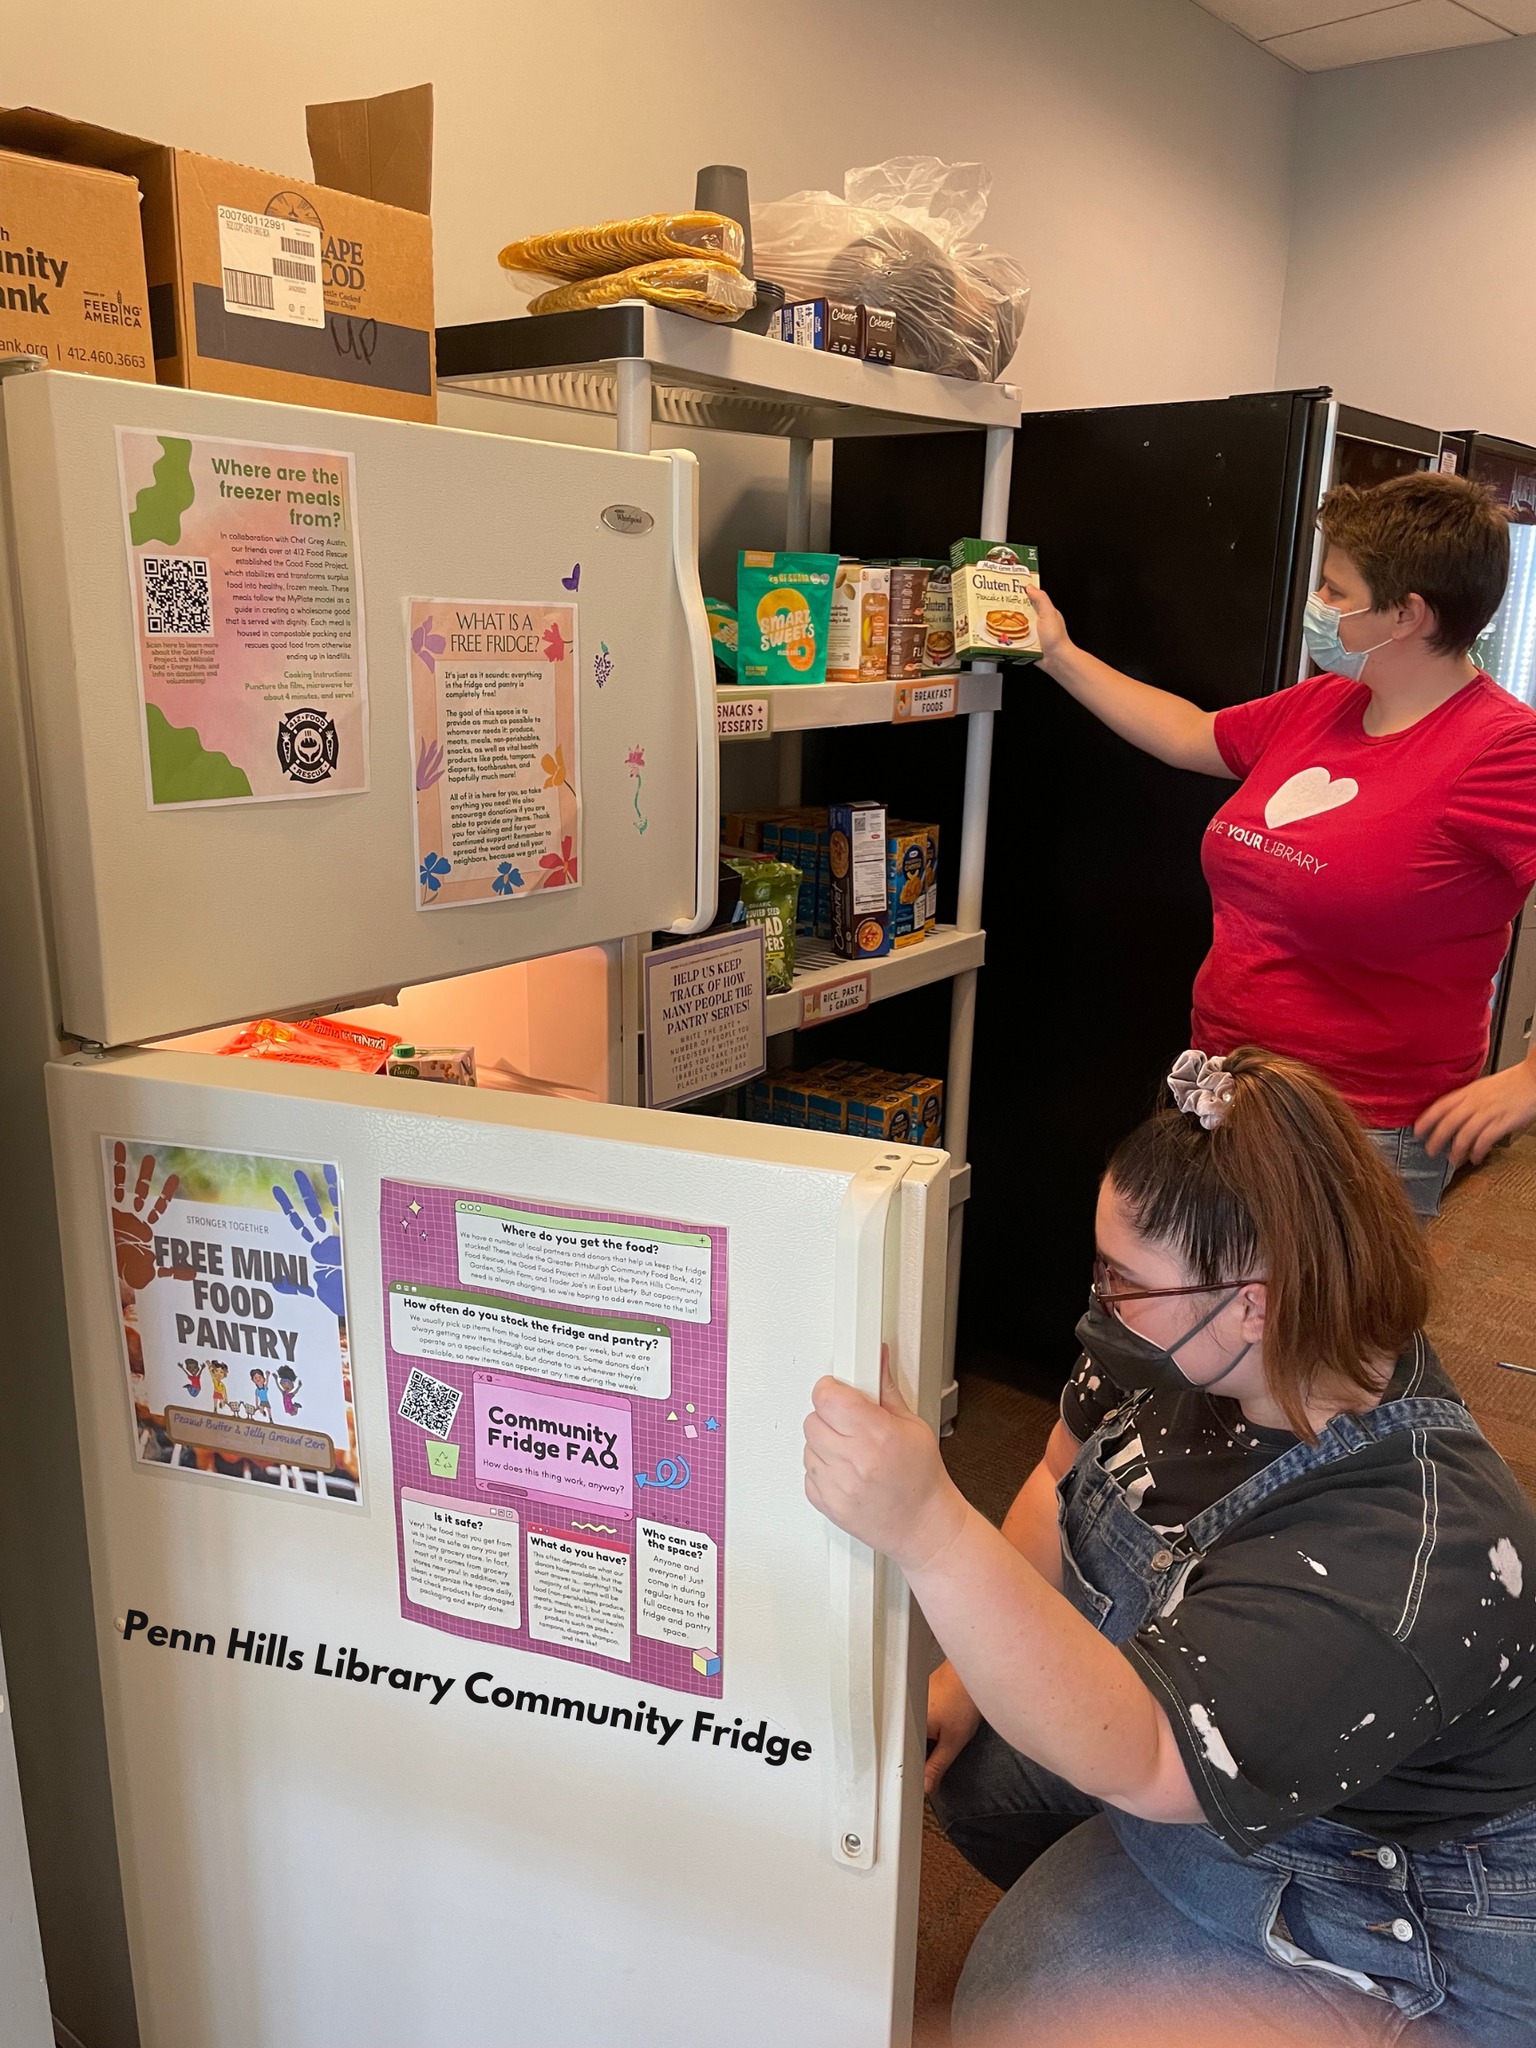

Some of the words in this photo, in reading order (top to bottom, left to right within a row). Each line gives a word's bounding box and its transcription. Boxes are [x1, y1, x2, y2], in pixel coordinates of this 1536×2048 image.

[219, 208, 286, 231] 200790112991
[321, 232, 364, 266] APE
[84, 299, 140, 316] FEEDING
[831, 308, 858, 324] Cabaret
[84, 311, 142, 328] AMERICA
[869, 315, 895, 331] Cabaret
[67, 347, 146, 369] 412.460.3663
[211, 458, 271, 479] Where
[277, 467, 306, 482] are
[312, 467, 339, 485] the
[219, 480, 281, 502] freezer
[287, 490, 341, 507] meals
[290, 508, 341, 527] from?
[616, 513, 643, 525] Whirlpool
[972, 574, 1010, 593] Gluten
[1012, 578, 1026, 593] Fr
[975, 592, 1001, 603] Pancake
[1005, 595, 1022, 605] Waffle
[456, 612, 505, 631] WHAT
[509, 613, 519, 631] IS
[522, 614, 533, 631] A
[760, 608, 811, 635] SMART
[451, 634, 482, 652] FREE
[487, 634, 540, 654] FRIDGE?
[760, 623, 816, 652] SWEETS
[286, 653, 308, 662] ending
[319, 652, 325, 660] in
[326, 652, 351, 660] landfills.
[245, 682, 276, 691] Puncture
[277, 681, 288, 690] the
[306, 681, 342, 689] microwave
[343, 680, 353, 688] for
[283, 670, 312, 680] Cooking
[313, 670, 352, 678] Instructions:
[445, 690, 480, 699] completely
[482, 689, 496, 697] free!
[914, 688, 953, 702] BREAKFAST
[717, 704, 754, 718] SNACKS
[921, 702, 944, 713] FOODS
[288, 714, 301, 728] 412
[305, 713, 325, 727] FOOD
[296, 766, 325, 779] RESCUE
[1227, 824, 1263, 850] YOUR
[1263, 838, 1329, 875] LIBRARY
[831, 881, 845, 951] Cabaret
[674, 969, 699, 986] HELP
[702, 965, 715, 979] US
[717, 958, 741, 975] KEEP
[670, 983, 705, 1002] TRACK
[707, 978, 721, 993] OF
[723, 971, 745, 988] HOW
[663, 1001, 692, 1021] MANY
[695, 989, 733, 1012] PEOPLE
[735, 985, 752, 1001] THE
[835, 996, 859, 1010] GRAINS
[667, 1012, 708, 1034] PANTRY
[711, 999, 750, 1022] SERVES!
[393, 1066, 418, 1076] Pacific
[676, 1077, 698, 1090] PLACE
[701, 1073, 708, 1082] IT
[710, 1071, 718, 1079] IN
[720, 1065, 732, 1075] THE
[735, 1061, 746, 1070] BOX
[186, 1215, 227, 1229] STRONGER
[229, 1221, 269, 1234] TOGETHER
[502, 1223, 536, 1239] Where
[539, 1231, 552, 1241] do
[556, 1236, 576, 1245] you
[580, 1238, 599, 1248] get
[603, 1239, 622, 1250] the
[626, 1241, 658, 1254] food?
[154, 1235, 223, 1276] FREE
[232, 1246, 310, 1288] MINI
[193, 1279, 274, 1321] FOOD
[404, 1298, 426, 1309] How
[430, 1303, 459, 1315] often
[462, 1307, 475, 1317] do
[478, 1311, 498, 1321] you
[501, 1313, 529, 1328] stock
[531, 1319, 550, 1333] the
[551, 1323, 586, 1341] fridge
[588, 1330, 610, 1343] and
[612, 1334, 659, 1350] pantry?
[175, 1313, 299, 1363] PANTRY
[174, 1413, 203, 1427] Peanut
[205, 1418, 233, 1432] Butter
[243, 1422, 266, 1444] Jelly
[269, 1426, 303, 1446] Ground
[304, 1435, 327, 1450] Zero
[488, 1406, 618, 1450] Community
[488, 1429, 560, 1460] Fridge
[567, 1443, 620, 1471] FAQ
[483, 1459, 501, 1469] How
[503, 1462, 523, 1474] does
[525, 1467, 539, 1477] this
[541, 1470, 562, 1484] thing
[564, 1477, 586, 1488] work,
[588, 1482, 624, 1495] anyway?
[434, 1511, 442, 1522] Is
[445, 1513, 452, 1524] it
[455, 1518, 483, 1530] safe?
[642, 1527, 666, 1541] Who
[668, 1536, 687, 1546] can
[689, 1541, 708, 1551] use
[647, 1539, 665, 1551] the
[667, 1545, 706, 1559] space?
[530, 1536, 557, 1550] What
[559, 1543, 572, 1554] do
[574, 1548, 594, 1559] you
[596, 1551, 627, 1566] have?
[653, 1555, 682, 1569] Anyone
[683, 1564, 699, 1573] and
[649, 1567, 686, 1581] everyone!
[688, 1576, 704, 1585] Just
[644, 1588, 672, 1600] regular
[674, 1594, 695, 1606] hours
[697, 1596, 709, 1609] for
[647, 1578, 669, 1588] come
[671, 1583, 678, 1591] in
[680, 1585, 706, 1599] during
[643, 1597, 655, 1610] full
[657, 1603, 684, 1615] access
[686, 1609, 695, 1618] to
[697, 1611, 710, 1621] the
[643, 1608, 666, 1622] fridge
[667, 1617, 683, 1626] and
[685, 1622, 711, 1633] pantry
[663, 1627, 689, 1639] space.
[120, 1609, 216, 1655] Penn
[227, 1627, 304, 1671] Hills
[314, 1643, 456, 1706] Library
[465, 1671, 684, 1746] Community
[692, 1710, 812, 1767] Fridge
